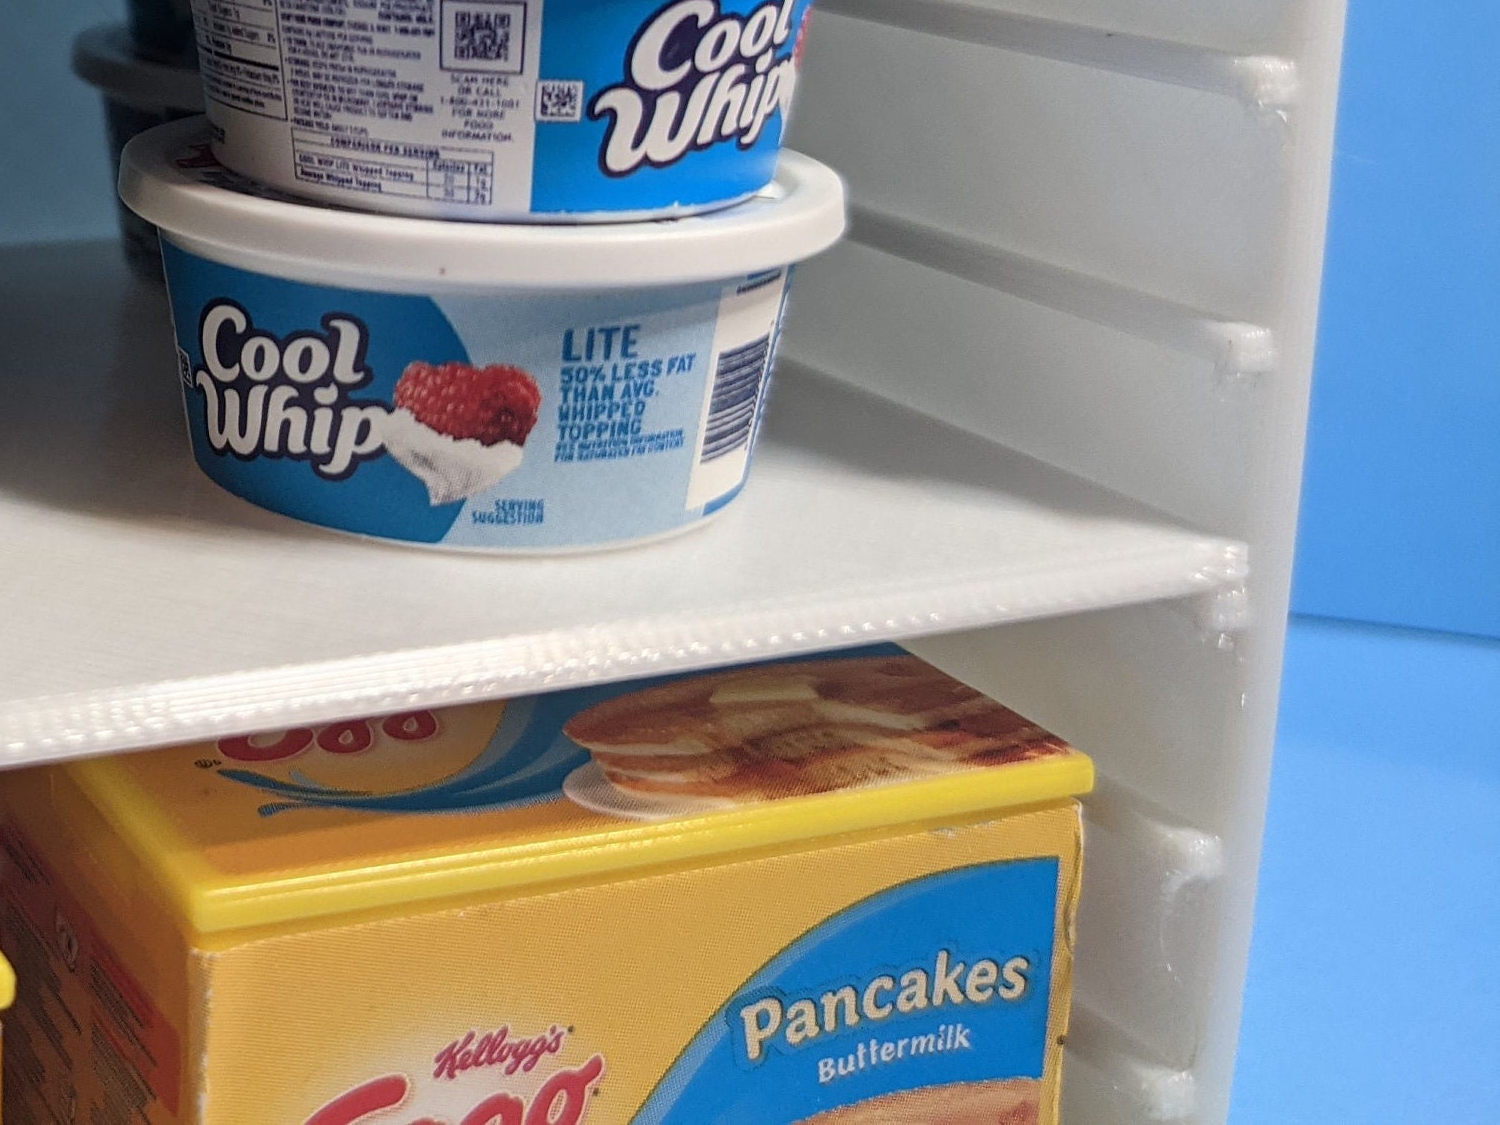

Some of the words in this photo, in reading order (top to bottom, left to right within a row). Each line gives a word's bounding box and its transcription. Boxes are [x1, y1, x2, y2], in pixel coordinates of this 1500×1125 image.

[591, 50, 797, 175] Whip
[199, 302, 367, 385] Cool
[559, 364, 607, 385] 50%
[611, 357, 664, 383] LESS
[665, 352, 697, 376] FAT
[561, 323, 641, 362] LITE
[558, 400, 647, 423] WHIPPED
[560, 382, 615, 405] THAN
[195, 382, 390, 476] Whip
[558, 416, 643, 443] TOPPING
[739, 948, 1033, 1061] Pancakes
[432, 1023, 566, 1081] Kellogg's
[815, 1022, 973, 1085] Buttermilk
